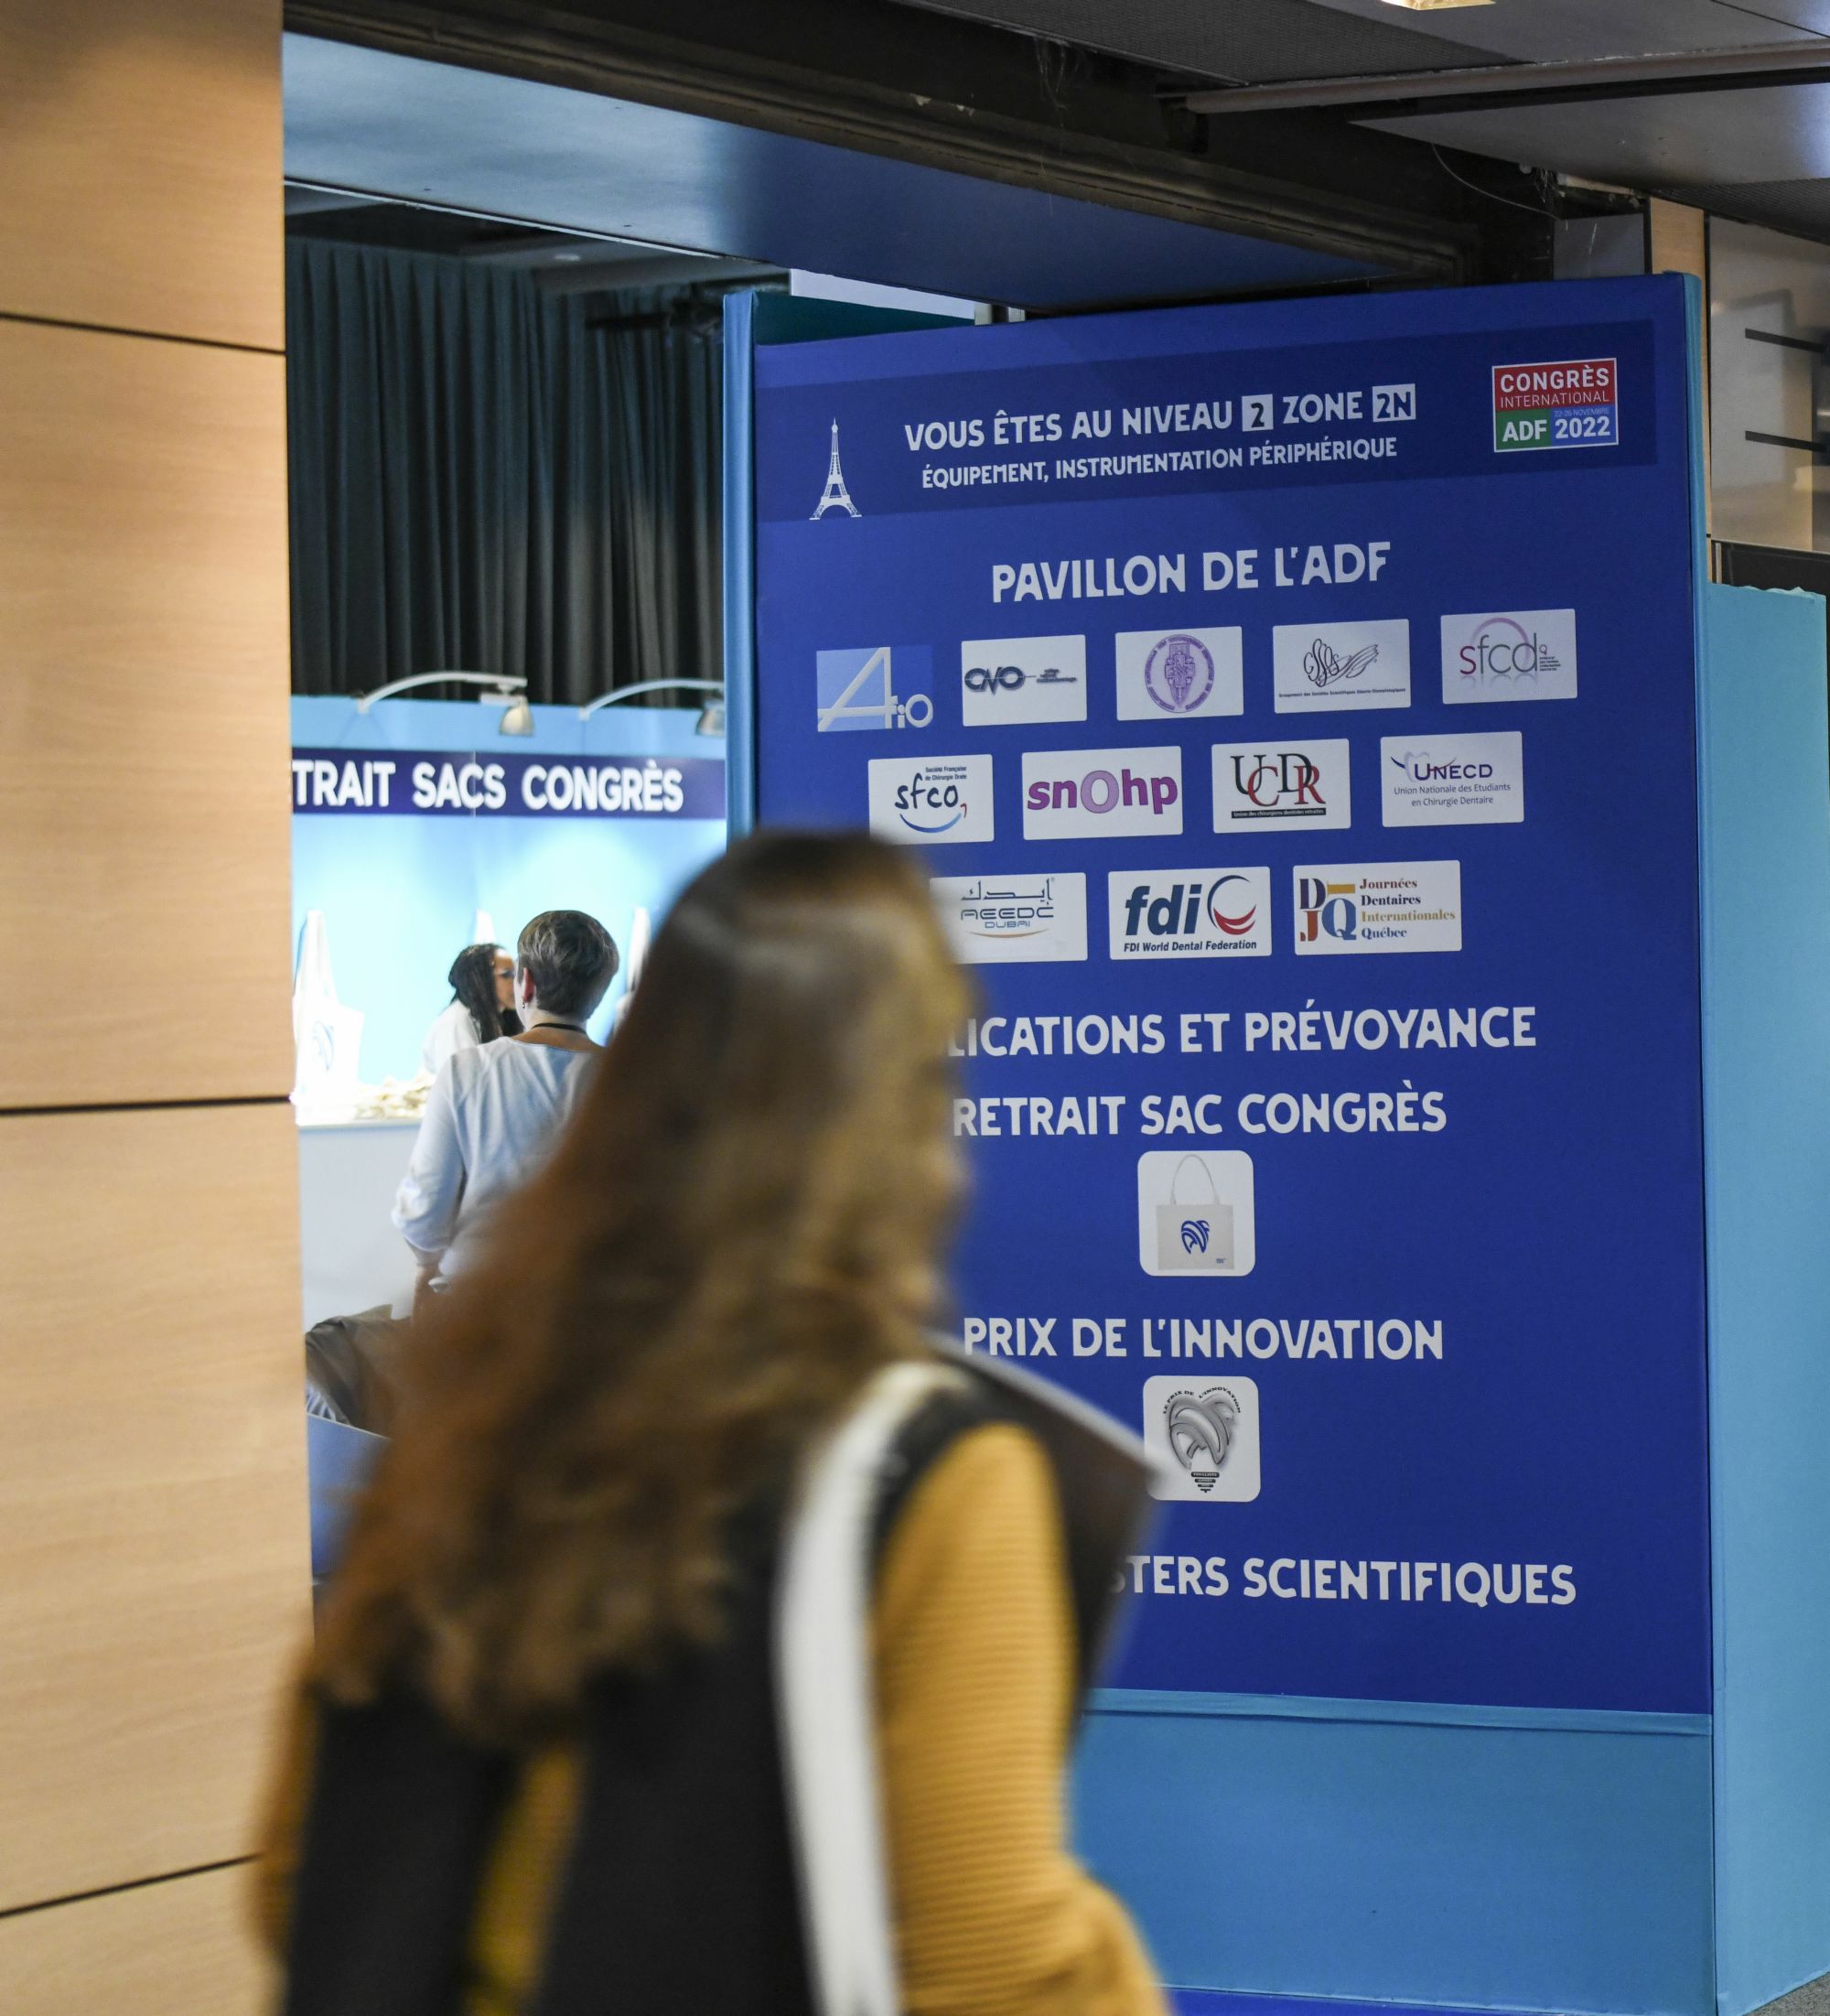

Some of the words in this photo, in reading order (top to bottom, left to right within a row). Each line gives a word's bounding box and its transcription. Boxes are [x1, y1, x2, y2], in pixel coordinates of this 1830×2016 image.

[1501, 364, 1609, 393] CONGRÈS
[1501, 391, 1609, 408] INTERNATIONAL
[905, 419, 985, 451] VOUS
[994, 409, 1062, 445] ÊTES
[1071, 409, 1112, 439] AU
[1122, 401, 1233, 436] NIVEAU
[1250, 402, 1265, 428] 2
[1282, 391, 1363, 424] ZONE
[1375, 391, 1412, 418] 2N
[1502, 419, 1547, 442] ADF
[1556, 415, 1610, 439] 2022
[922, 461, 1050, 490] ÉQUIPEMENT,
[1056, 447, 1243, 480] INSTRUMENTATION
[1250, 436, 1397, 466] PÉRIPHÉRIQUE
[993, 554, 1186, 603] PAVILLON
[1203, 549, 1259, 591] DE
[1276, 542, 1391, 587] L'ADF
[1459, 632, 1537, 674] sfcd
[292, 759, 396, 807] TRAIT
[412, 761, 507, 809] SACS
[521, 758, 684, 813] CONGRÈS
[1414, 763, 1493, 781] UNECD
[894, 772, 959, 810] sfco
[1394, 787, 1417, 795] Union
[1419, 785, 1457, 794] Nationale
[1459, 784, 1472, 792] des
[1474, 783, 1511, 792] Etudiants
[1423, 797, 1459, 807] Chirurgie
[1460, 796, 1493, 804] Dentaire
[1360, 878, 1418, 890] Journées
[961, 906, 1054, 921] AEEDC
[1125, 884, 1202, 936] fdi
[1362, 894, 1422, 907] Dentaires
[1362, 909, 1456, 922] Internationales
[1124, 943, 1140, 953] FDI
[1143, 942, 1169, 952] World
[1171, 941, 1203, 951] Dental
[1206, 939, 1257, 951] Federation
[1362, 927, 1407, 940] Québec
[948, 1014, 1166, 1057] LICATIONS
[1180, 1013, 1231, 1053] ET
[1244, 998, 1536, 1052] PRÉVOYANCE
[953, 1096, 1126, 1137] RETRAIT
[1140, 1094, 1222, 1136] SAC
[1238, 1079, 1447, 1134] CONGRÈS
[963, 1317, 1058, 1356] PRIX
[1072, 1318, 1127, 1357] DE
[1143, 1319, 1444, 1360] L'INNOVATION
[1243, 1558, 1577, 1608] SCIENTIFIQUES
